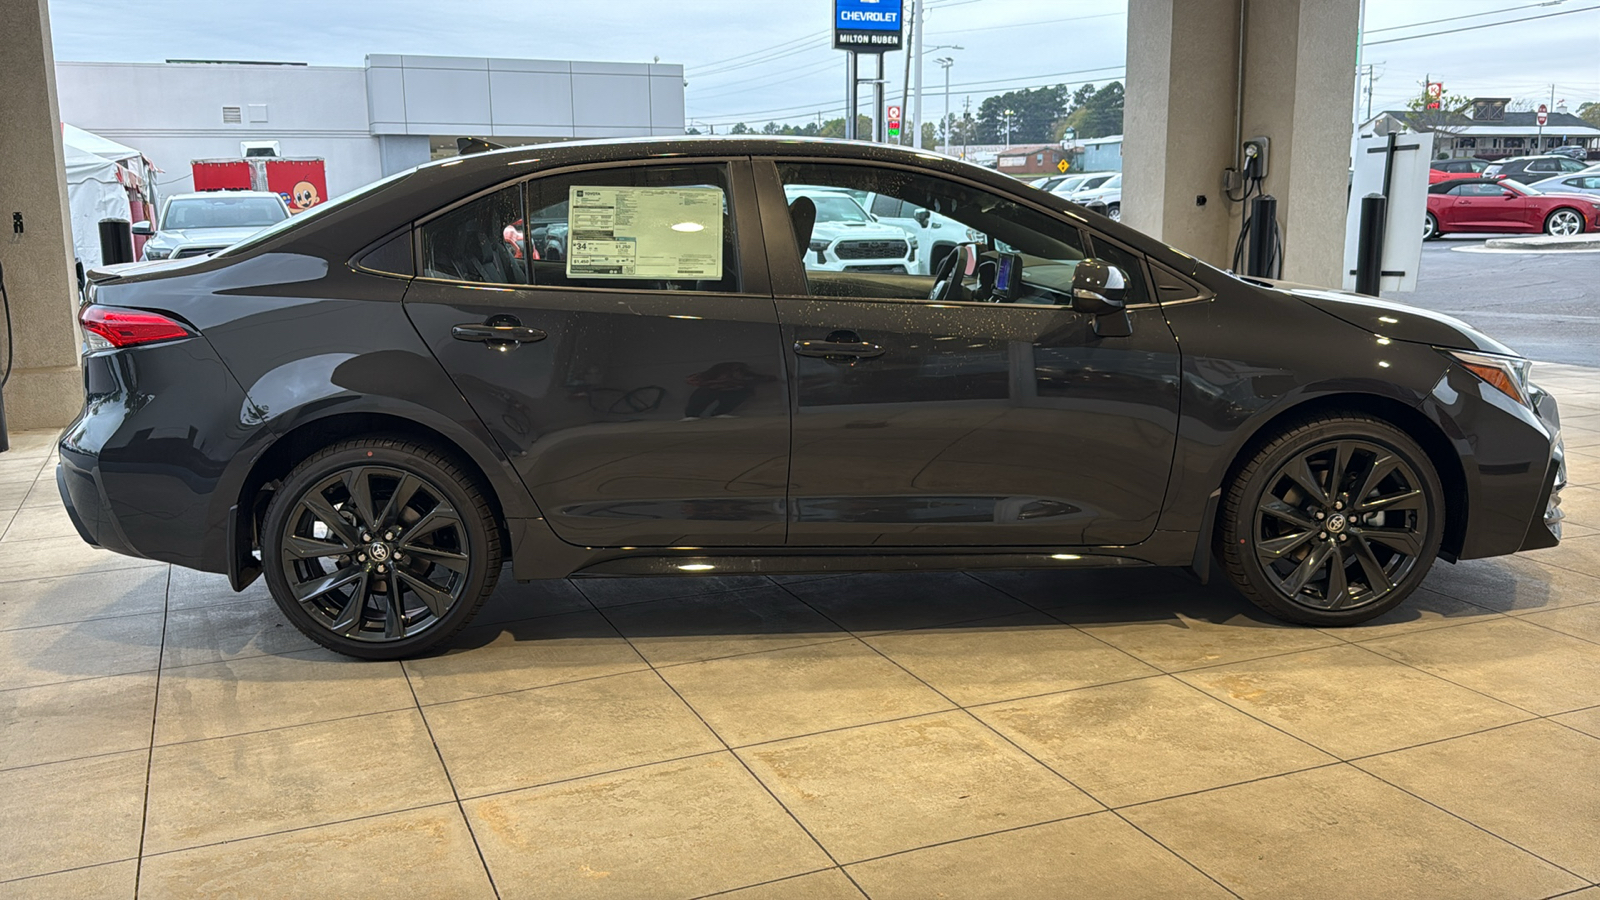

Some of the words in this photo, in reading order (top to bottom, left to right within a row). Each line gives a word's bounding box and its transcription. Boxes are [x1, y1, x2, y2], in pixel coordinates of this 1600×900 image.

[841, 11, 897, 22] CHEVROLET
[839, 34, 869, 43] MILTON
[871, 35, 898, 44] RUBEN
[576, 242, 587, 250] 34
